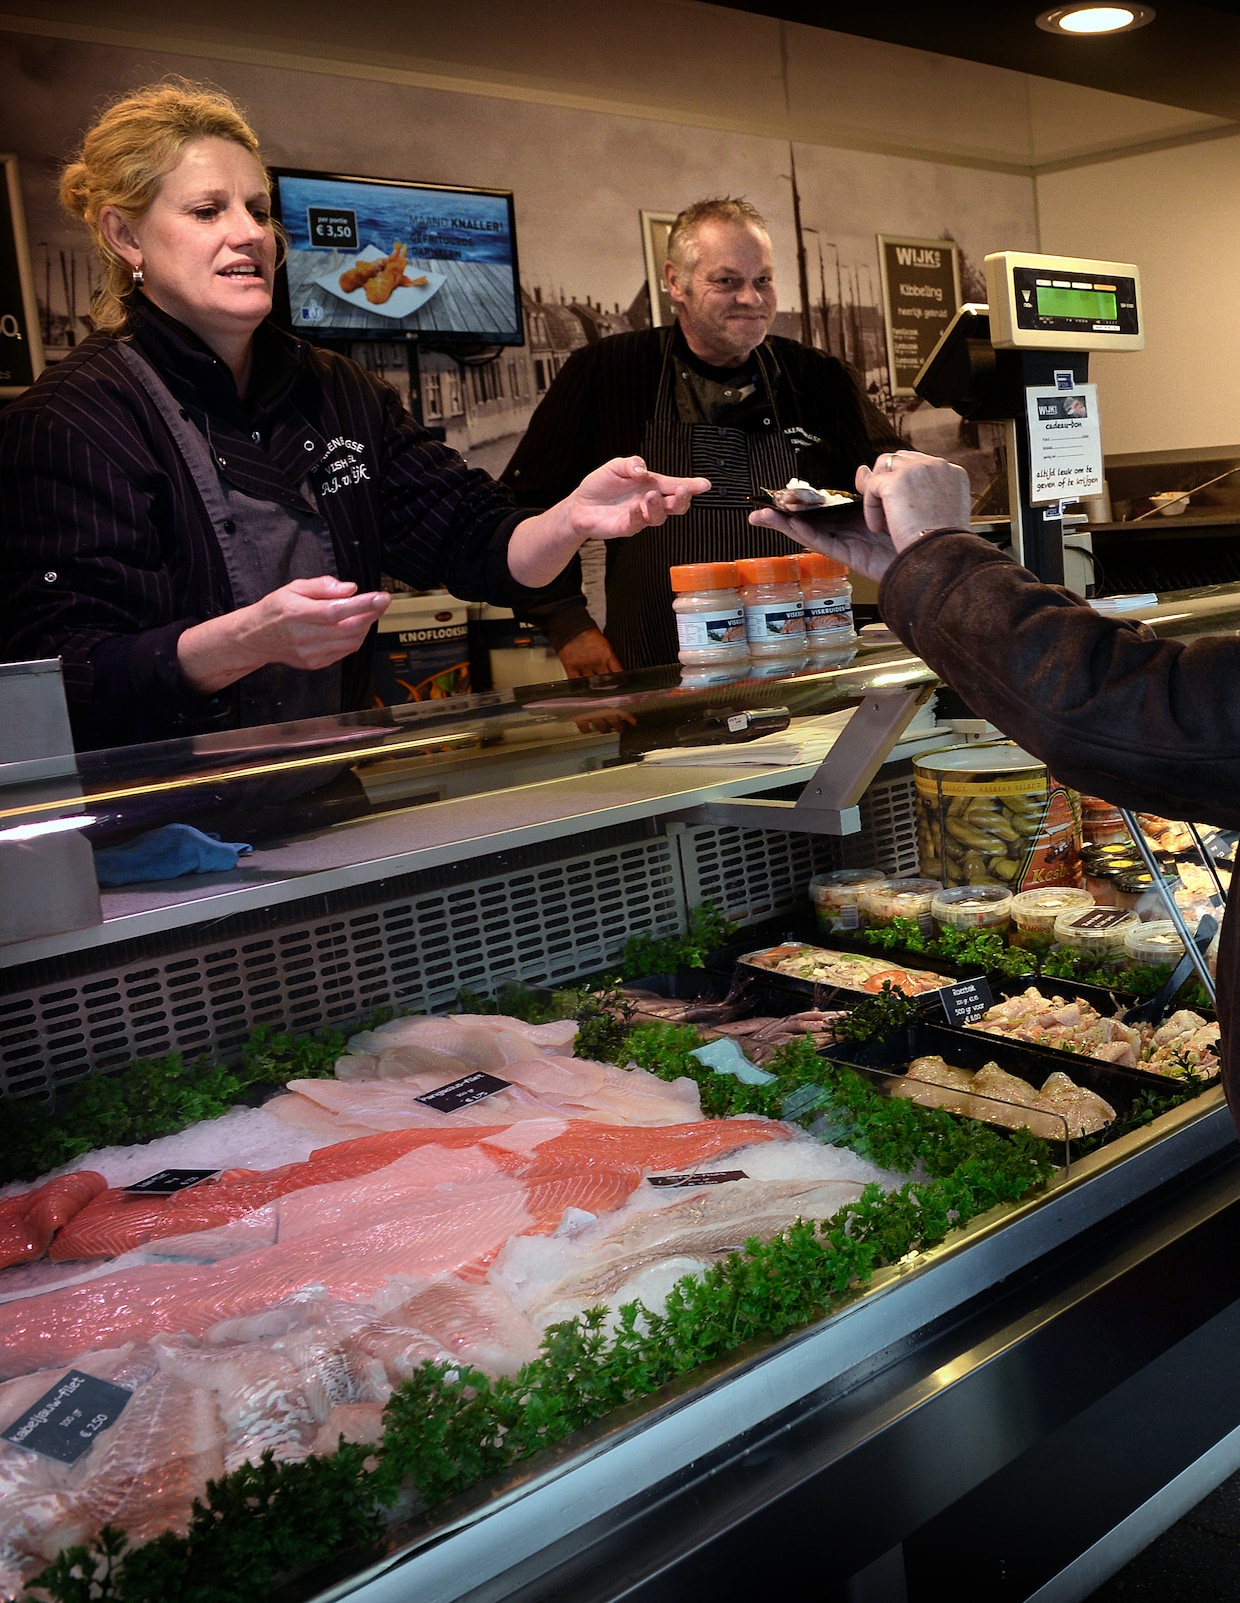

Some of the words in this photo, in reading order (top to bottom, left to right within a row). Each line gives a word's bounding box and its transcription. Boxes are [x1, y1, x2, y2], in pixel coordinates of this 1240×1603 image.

[451, 217, 503, 232] KNALLER!
[326, 225, 352, 238] 3,50
[899, 283, 943, 301] Kibbeling
[1045, 420, 1082, 430] cadeau-bon
[1057, 468, 1073, 476] leuk
[1036, 482, 1056, 492] geven
[1058, 477, 1066, 488] of
[1068, 478, 1074, 486] te
[810, 604, 846, 616] VISKRUIDEN
[979, 785, 1013, 793] KESBEKE
[1015, 782, 1041, 791] SELECT
[955, 1008, 966, 1016] 500
[972, 1003, 985, 1011] voor
[8, 1376, 86, 1443] kabeljauw-filet
